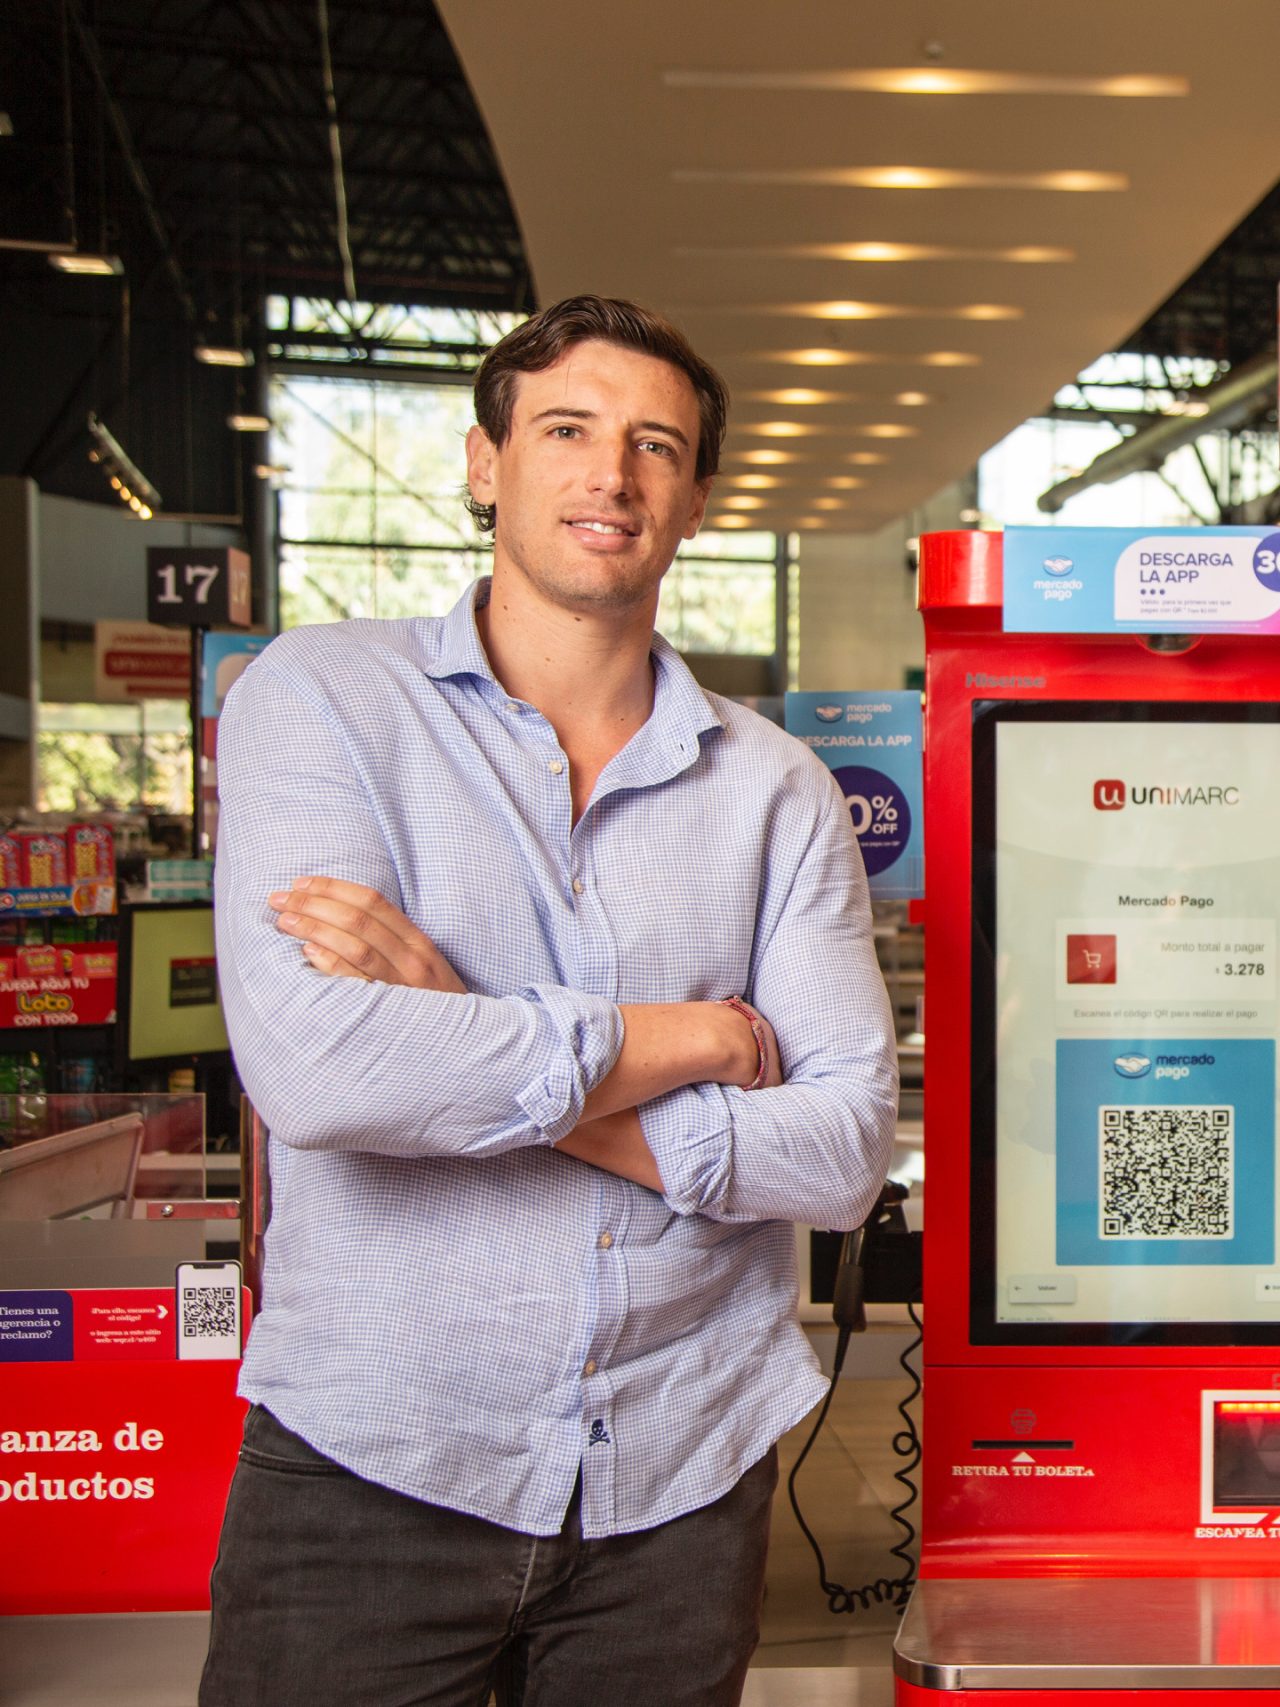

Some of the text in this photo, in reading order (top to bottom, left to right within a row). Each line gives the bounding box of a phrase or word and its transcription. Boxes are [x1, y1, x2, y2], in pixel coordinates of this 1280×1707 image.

[1140, 552, 1234, 567] DESCARGA
[1140, 570, 1199, 583] LA APP
[156, 564, 219, 604] 17
[1033, 579, 1083, 589] mercado
[1044, 590, 1072, 601] pago
[965, 673, 1046, 688] Hisense
[847, 703, 892, 713] mercado
[847, 713, 873, 723] pago
[867, 735, 883, 746] LA
[886, 735, 912, 746] APP
[872, 824, 898, 834] OFF
[1119, 895, 1214, 909] Mercado Pago
[1161, 942, 1265, 955] Monto total a pagar
[1224, 963, 1265, 976] 3.278
[0, 979, 36, 991] JUEGA
[19, 993, 71, 1012] Loto
[14, 1013, 78, 1025] CON TODO
[1154, 1009, 1168, 1018] QR
[1235, 1011, 1258, 1020] pago
[1156, 1053, 1215, 1066] mercado
[1155, 1067, 1190, 1080] pago
[37, 1308, 59, 1316] una
[1, 1330, 52, 1340] reclamo?
[114, 1422, 164, 1451] de
[952, 1466, 1010, 1476] RETIRA
[1013, 1466, 1033, 1476] TU
